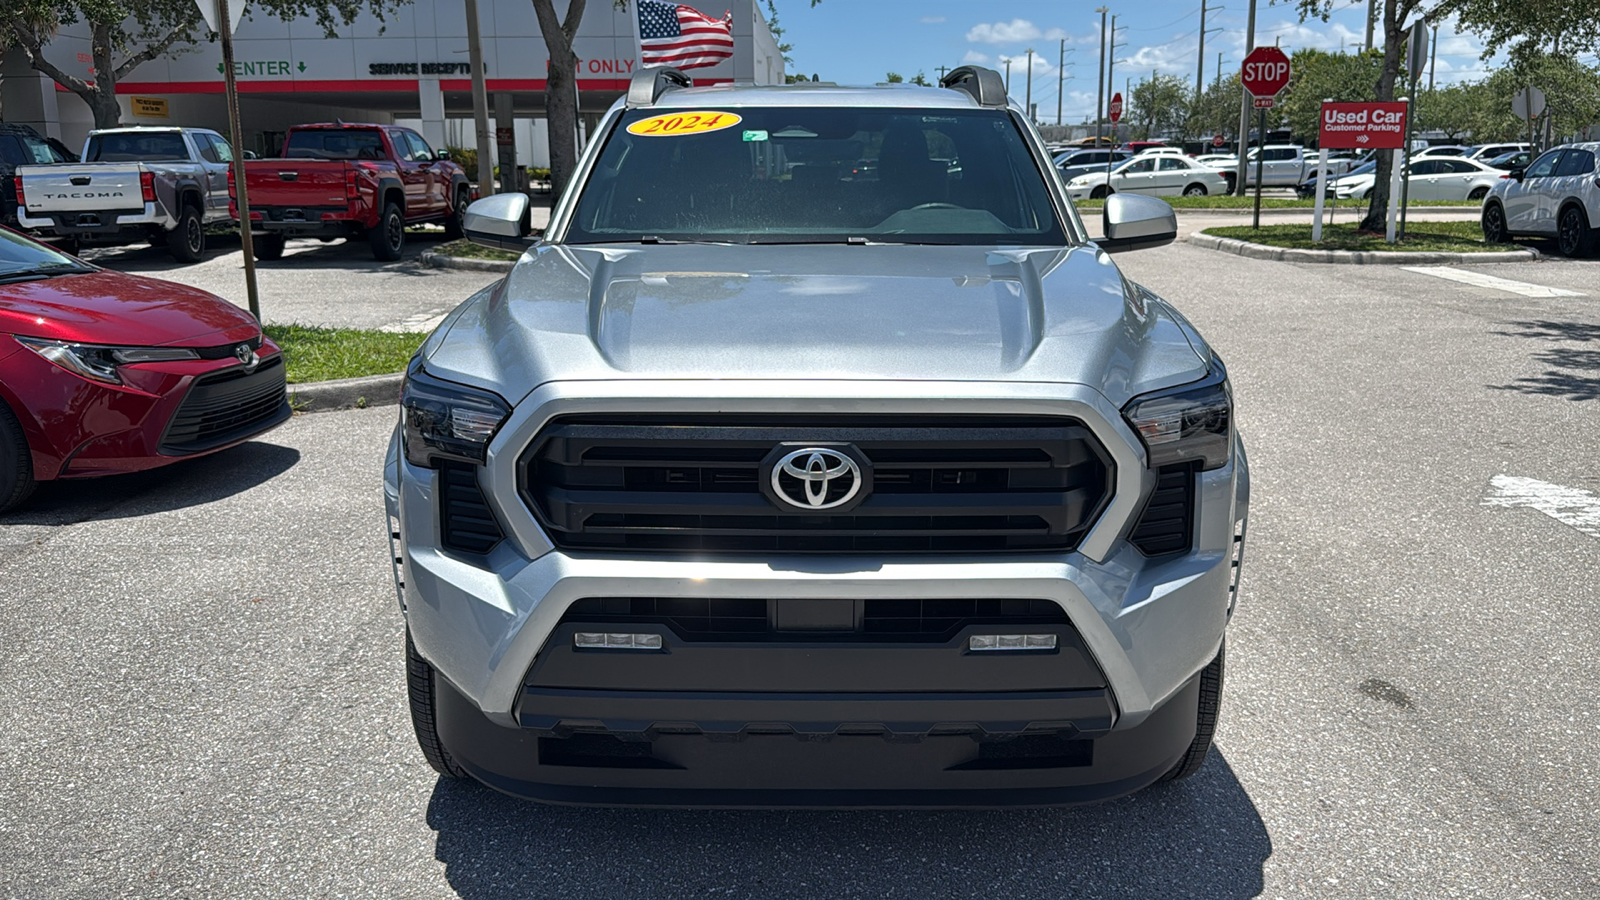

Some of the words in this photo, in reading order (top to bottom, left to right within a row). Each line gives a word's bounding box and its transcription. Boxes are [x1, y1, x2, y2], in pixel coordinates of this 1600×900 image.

[233, 61, 291, 75] ENTER
[369, 62, 418, 75] SERVICE
[421, 62, 487, 75] RECEPTI
[588, 59, 635, 74] ONLY
[1244, 62, 1288, 82] STOP
[642, 114, 724, 134] 2024
[1324, 109, 1368, 124] Used
[1371, 109, 1403, 124] Car
[1324, 124, 1366, 132] Customer
[1367, 123, 1401, 133] Parking
